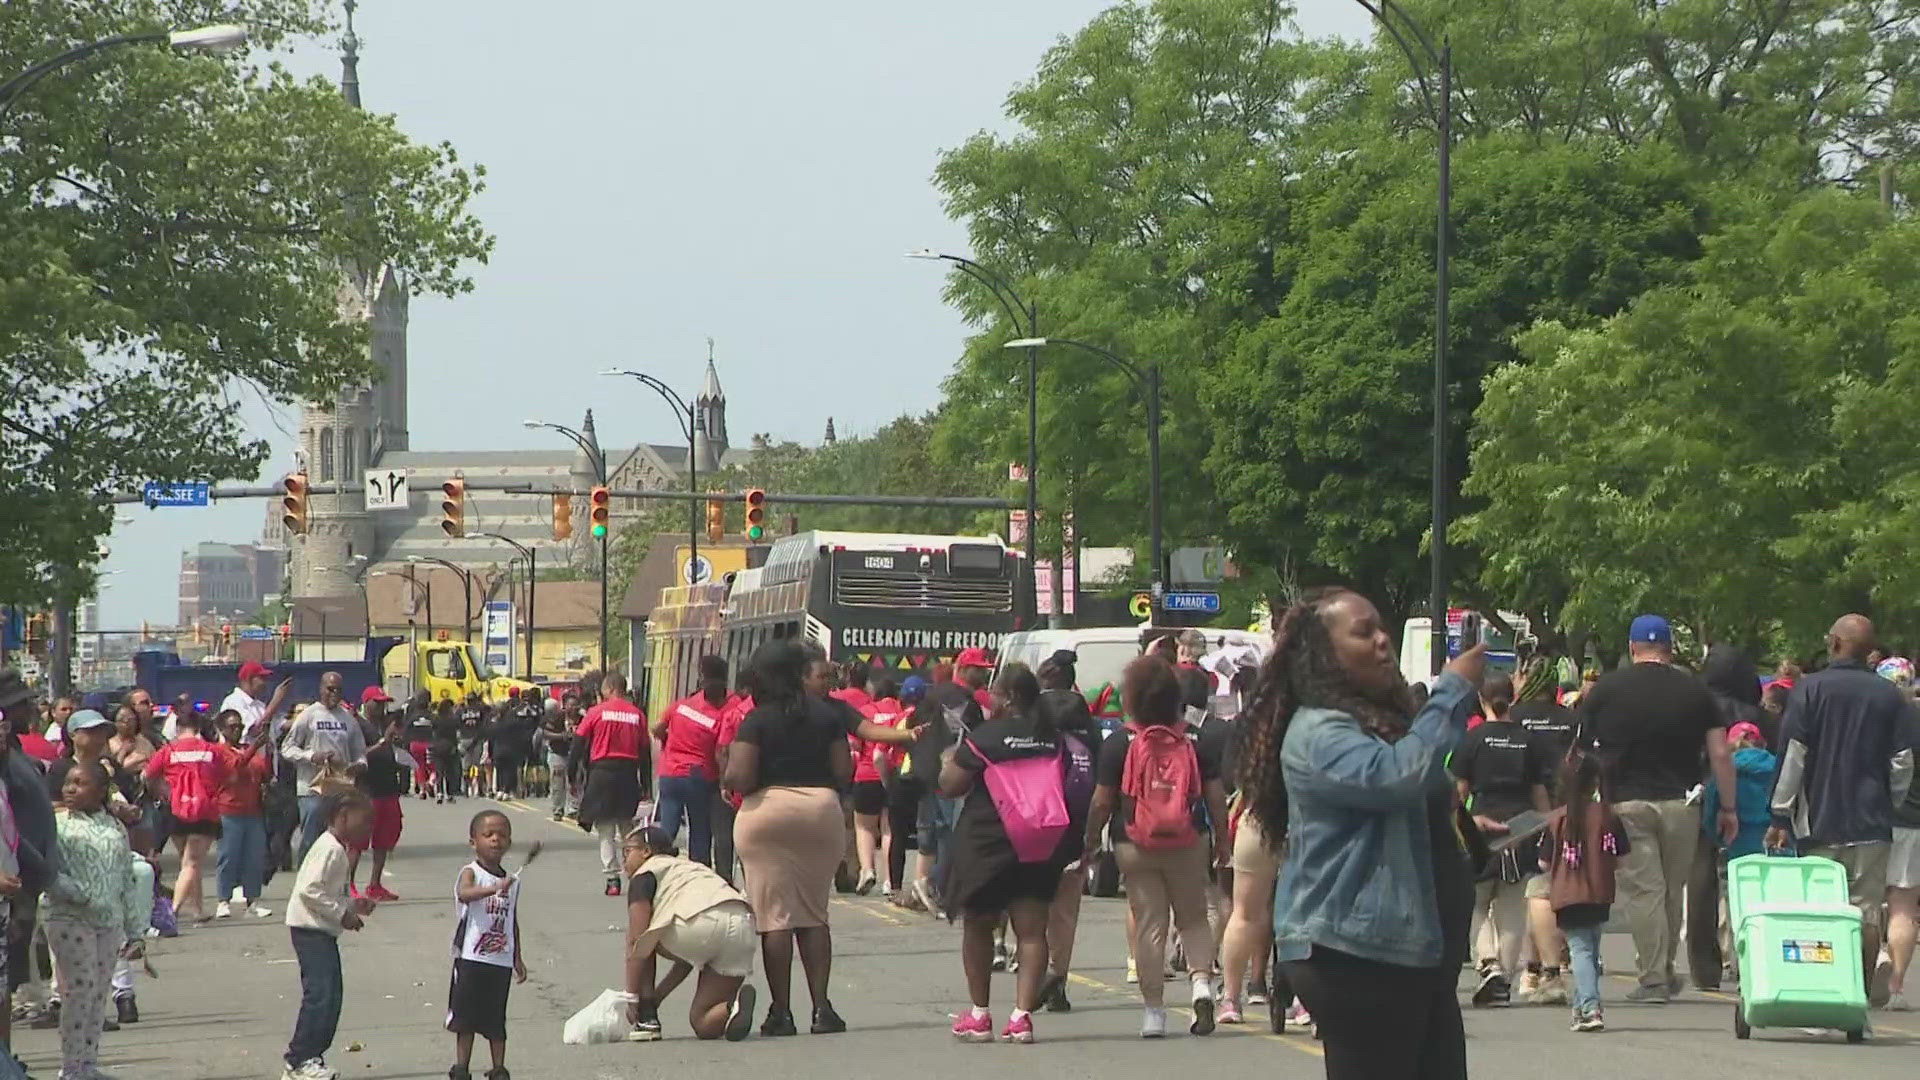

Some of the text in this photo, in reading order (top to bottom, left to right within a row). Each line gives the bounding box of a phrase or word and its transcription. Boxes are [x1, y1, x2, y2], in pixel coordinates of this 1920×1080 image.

[369, 496, 385, 504] ONLY
[864, 555, 894, 569] 1604
[1175, 596, 1207, 609] PARADE
[842, 628, 940, 650] CELEBRATING
